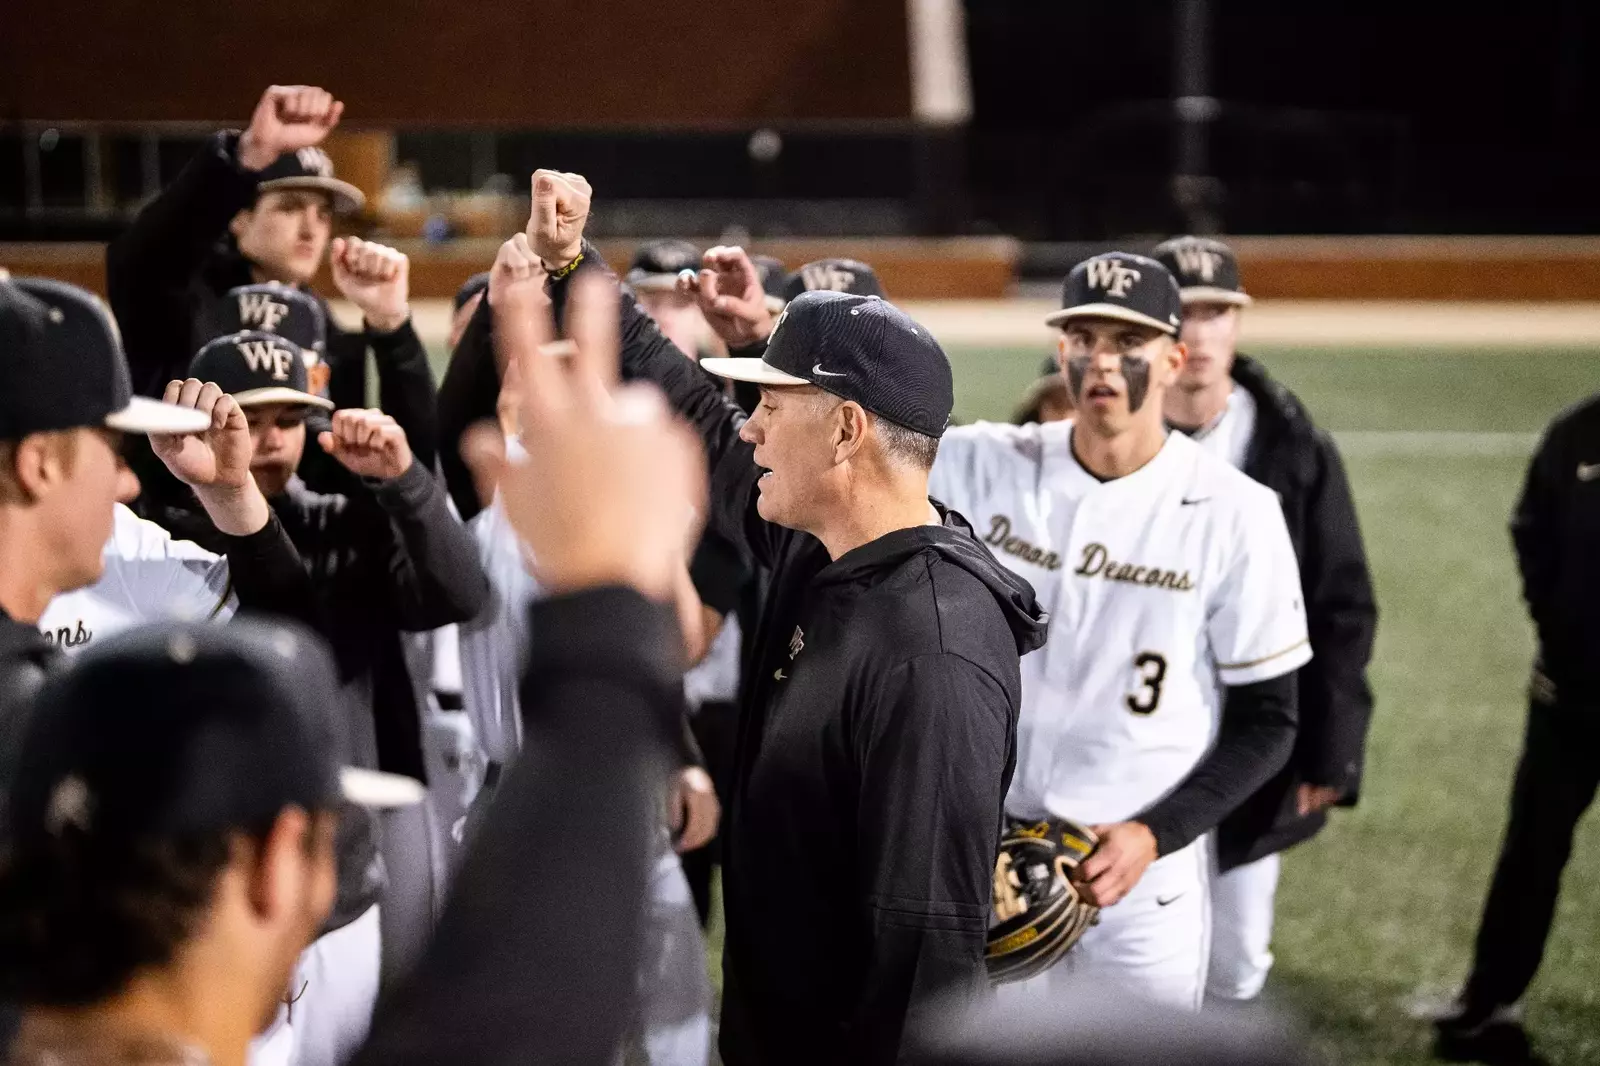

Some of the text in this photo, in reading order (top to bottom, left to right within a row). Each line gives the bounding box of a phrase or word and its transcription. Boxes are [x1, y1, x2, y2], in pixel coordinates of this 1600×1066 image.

[1086, 259, 1141, 298] WF
[238, 292, 289, 332] WF
[237, 340, 293, 380] WF
[985, 514, 1194, 591] Demon Deacons
[1125, 650, 1168, 716] 3
